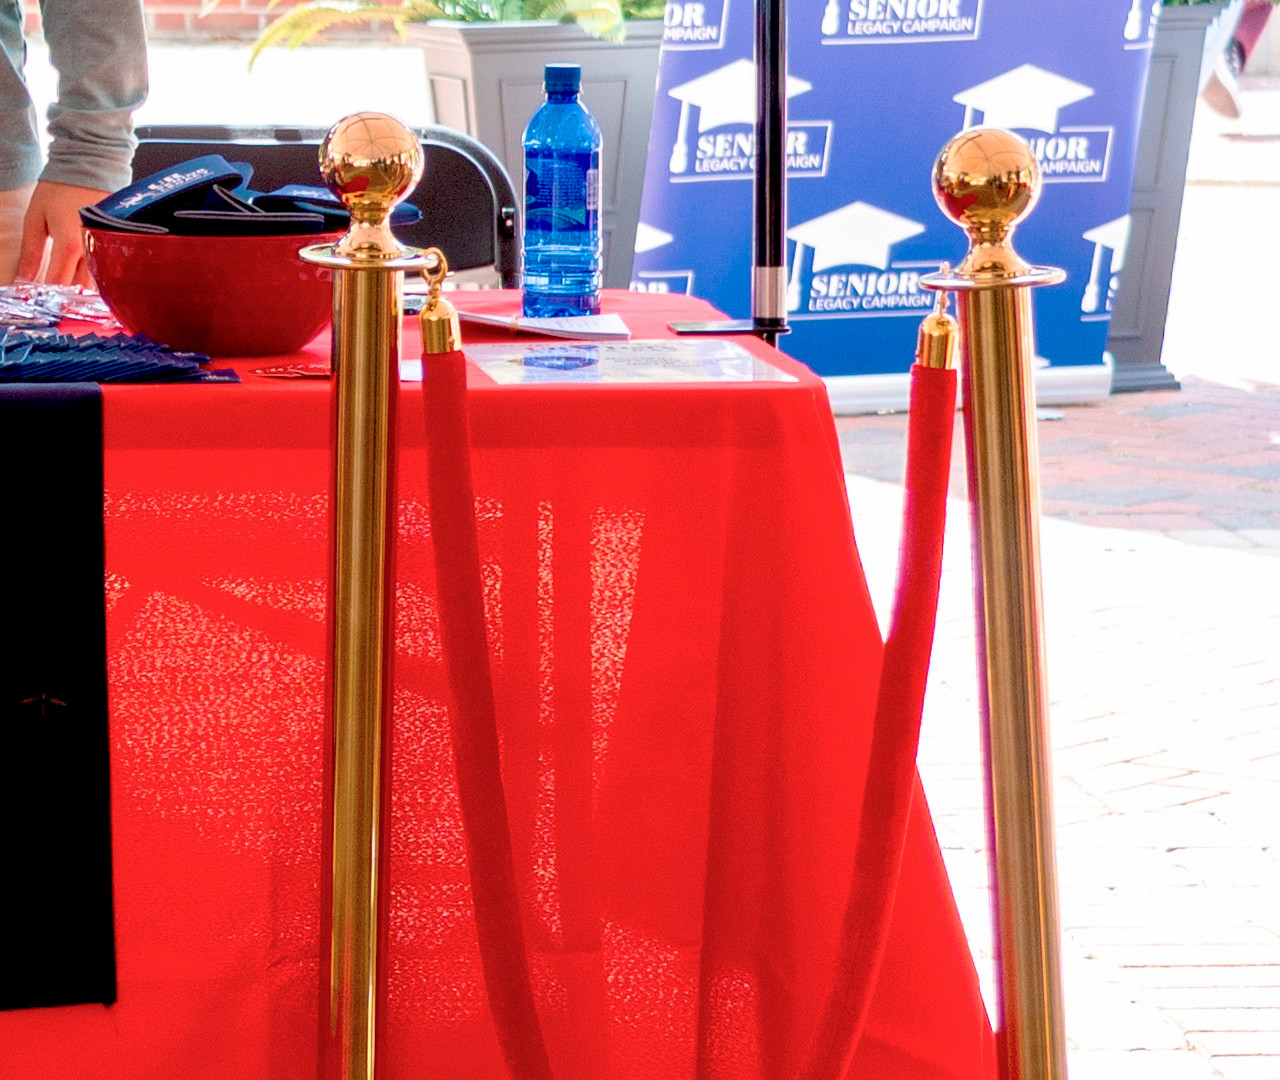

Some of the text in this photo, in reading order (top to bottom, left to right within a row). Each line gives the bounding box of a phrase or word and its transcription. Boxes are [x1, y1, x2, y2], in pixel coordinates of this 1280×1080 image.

[847, 17, 972, 35] LEGACY CAMPAIGN
[695, 157, 748, 172] LEGACY
[811, 272, 919, 298] SENIOR
[809, 293, 930, 311] LEGACY CAMPAIGN
